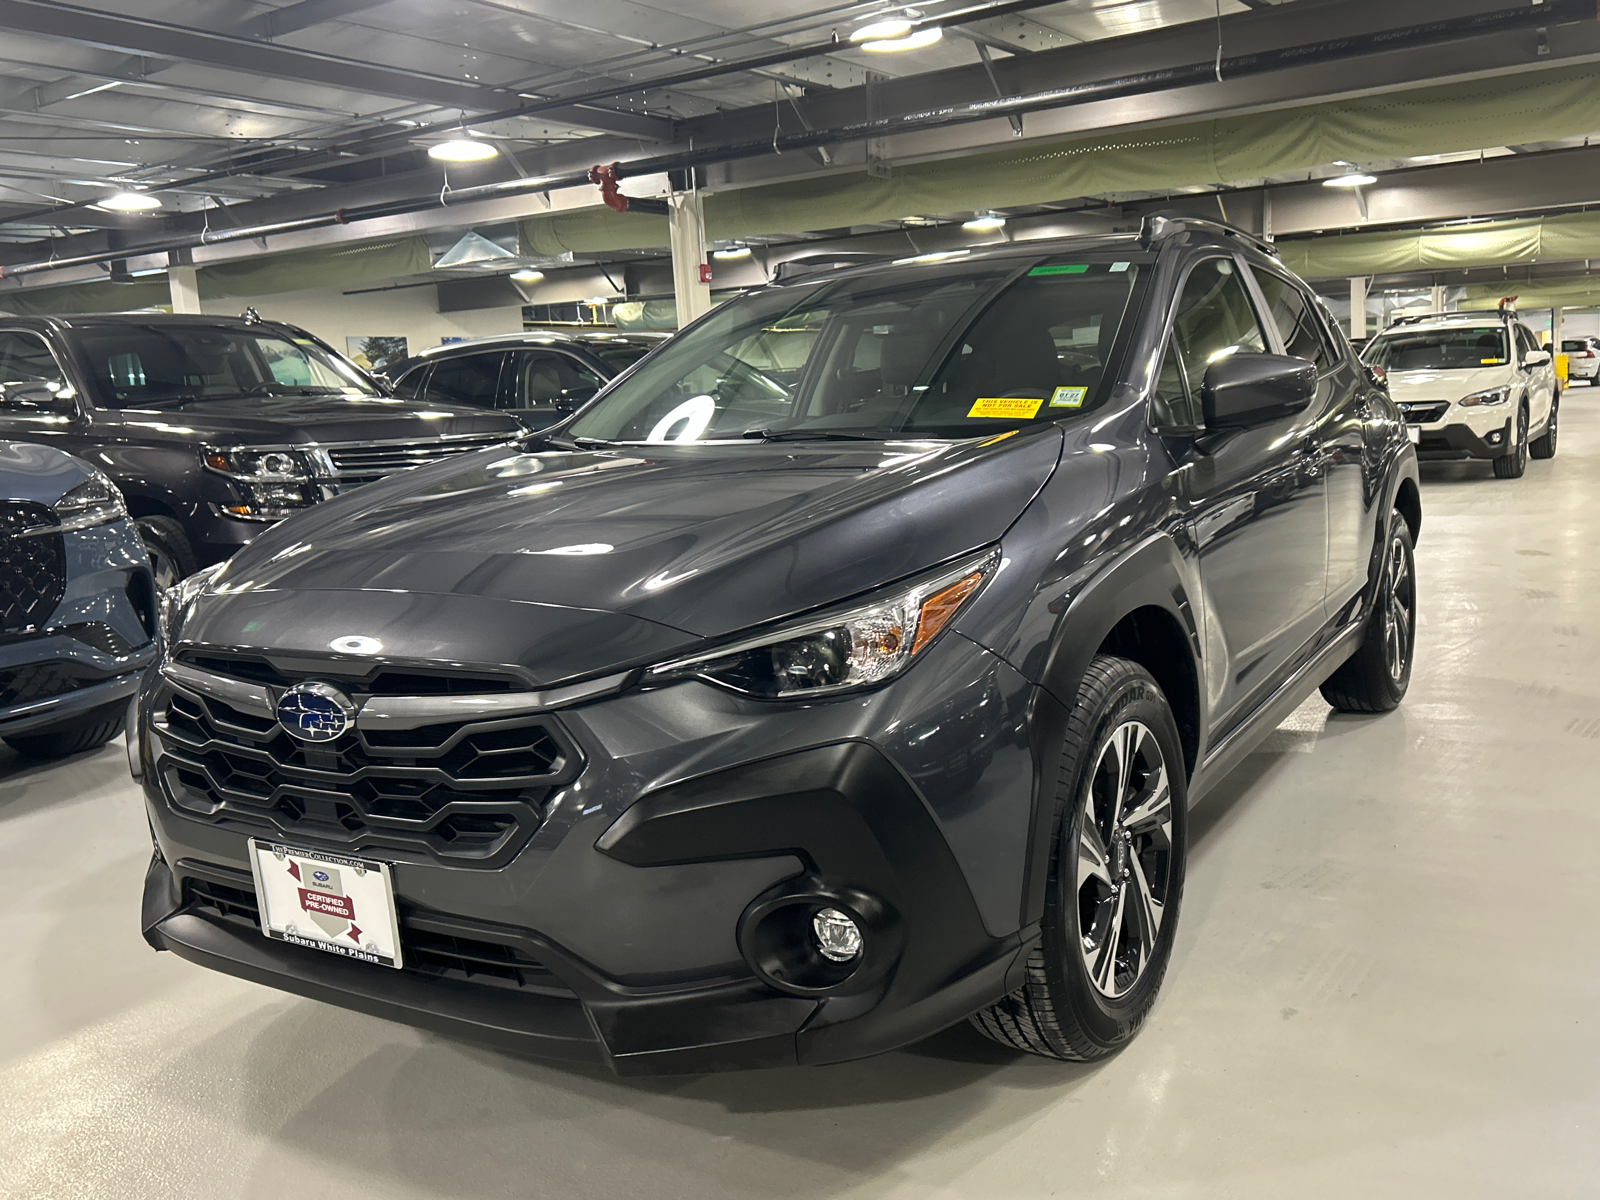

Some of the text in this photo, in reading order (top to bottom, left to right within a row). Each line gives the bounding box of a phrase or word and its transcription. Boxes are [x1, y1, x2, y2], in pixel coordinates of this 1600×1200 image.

[312, 881, 334, 890] SUBARU
[305, 899, 349, 916] PRE-OWNED
[307, 892, 344, 907] CERTIFIED
[282, 932, 380, 963] Subaru White Plains
